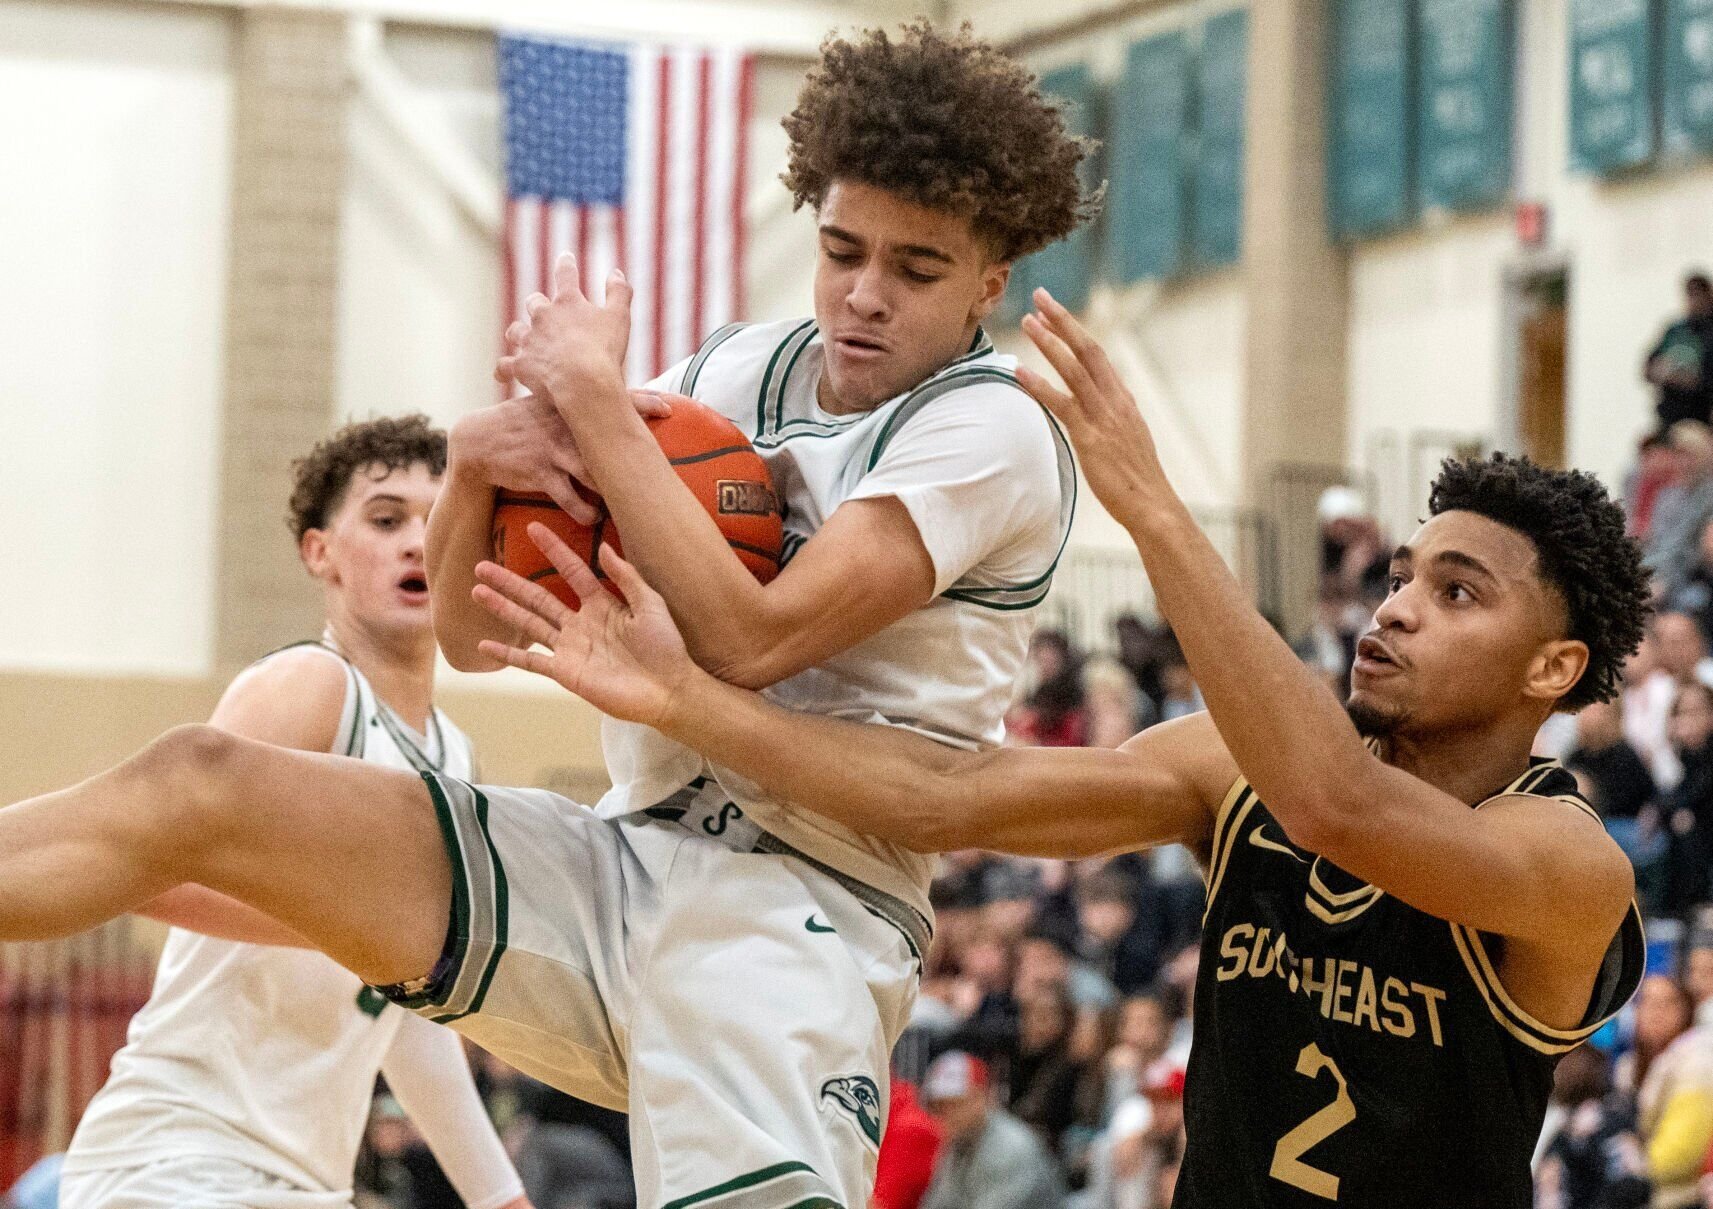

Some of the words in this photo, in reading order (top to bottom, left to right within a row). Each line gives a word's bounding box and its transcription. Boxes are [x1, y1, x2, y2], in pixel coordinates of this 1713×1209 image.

[702, 801, 743, 836] S
[1216, 922, 1446, 1047] SOHEAST
[1269, 1042, 1357, 1201] 2
